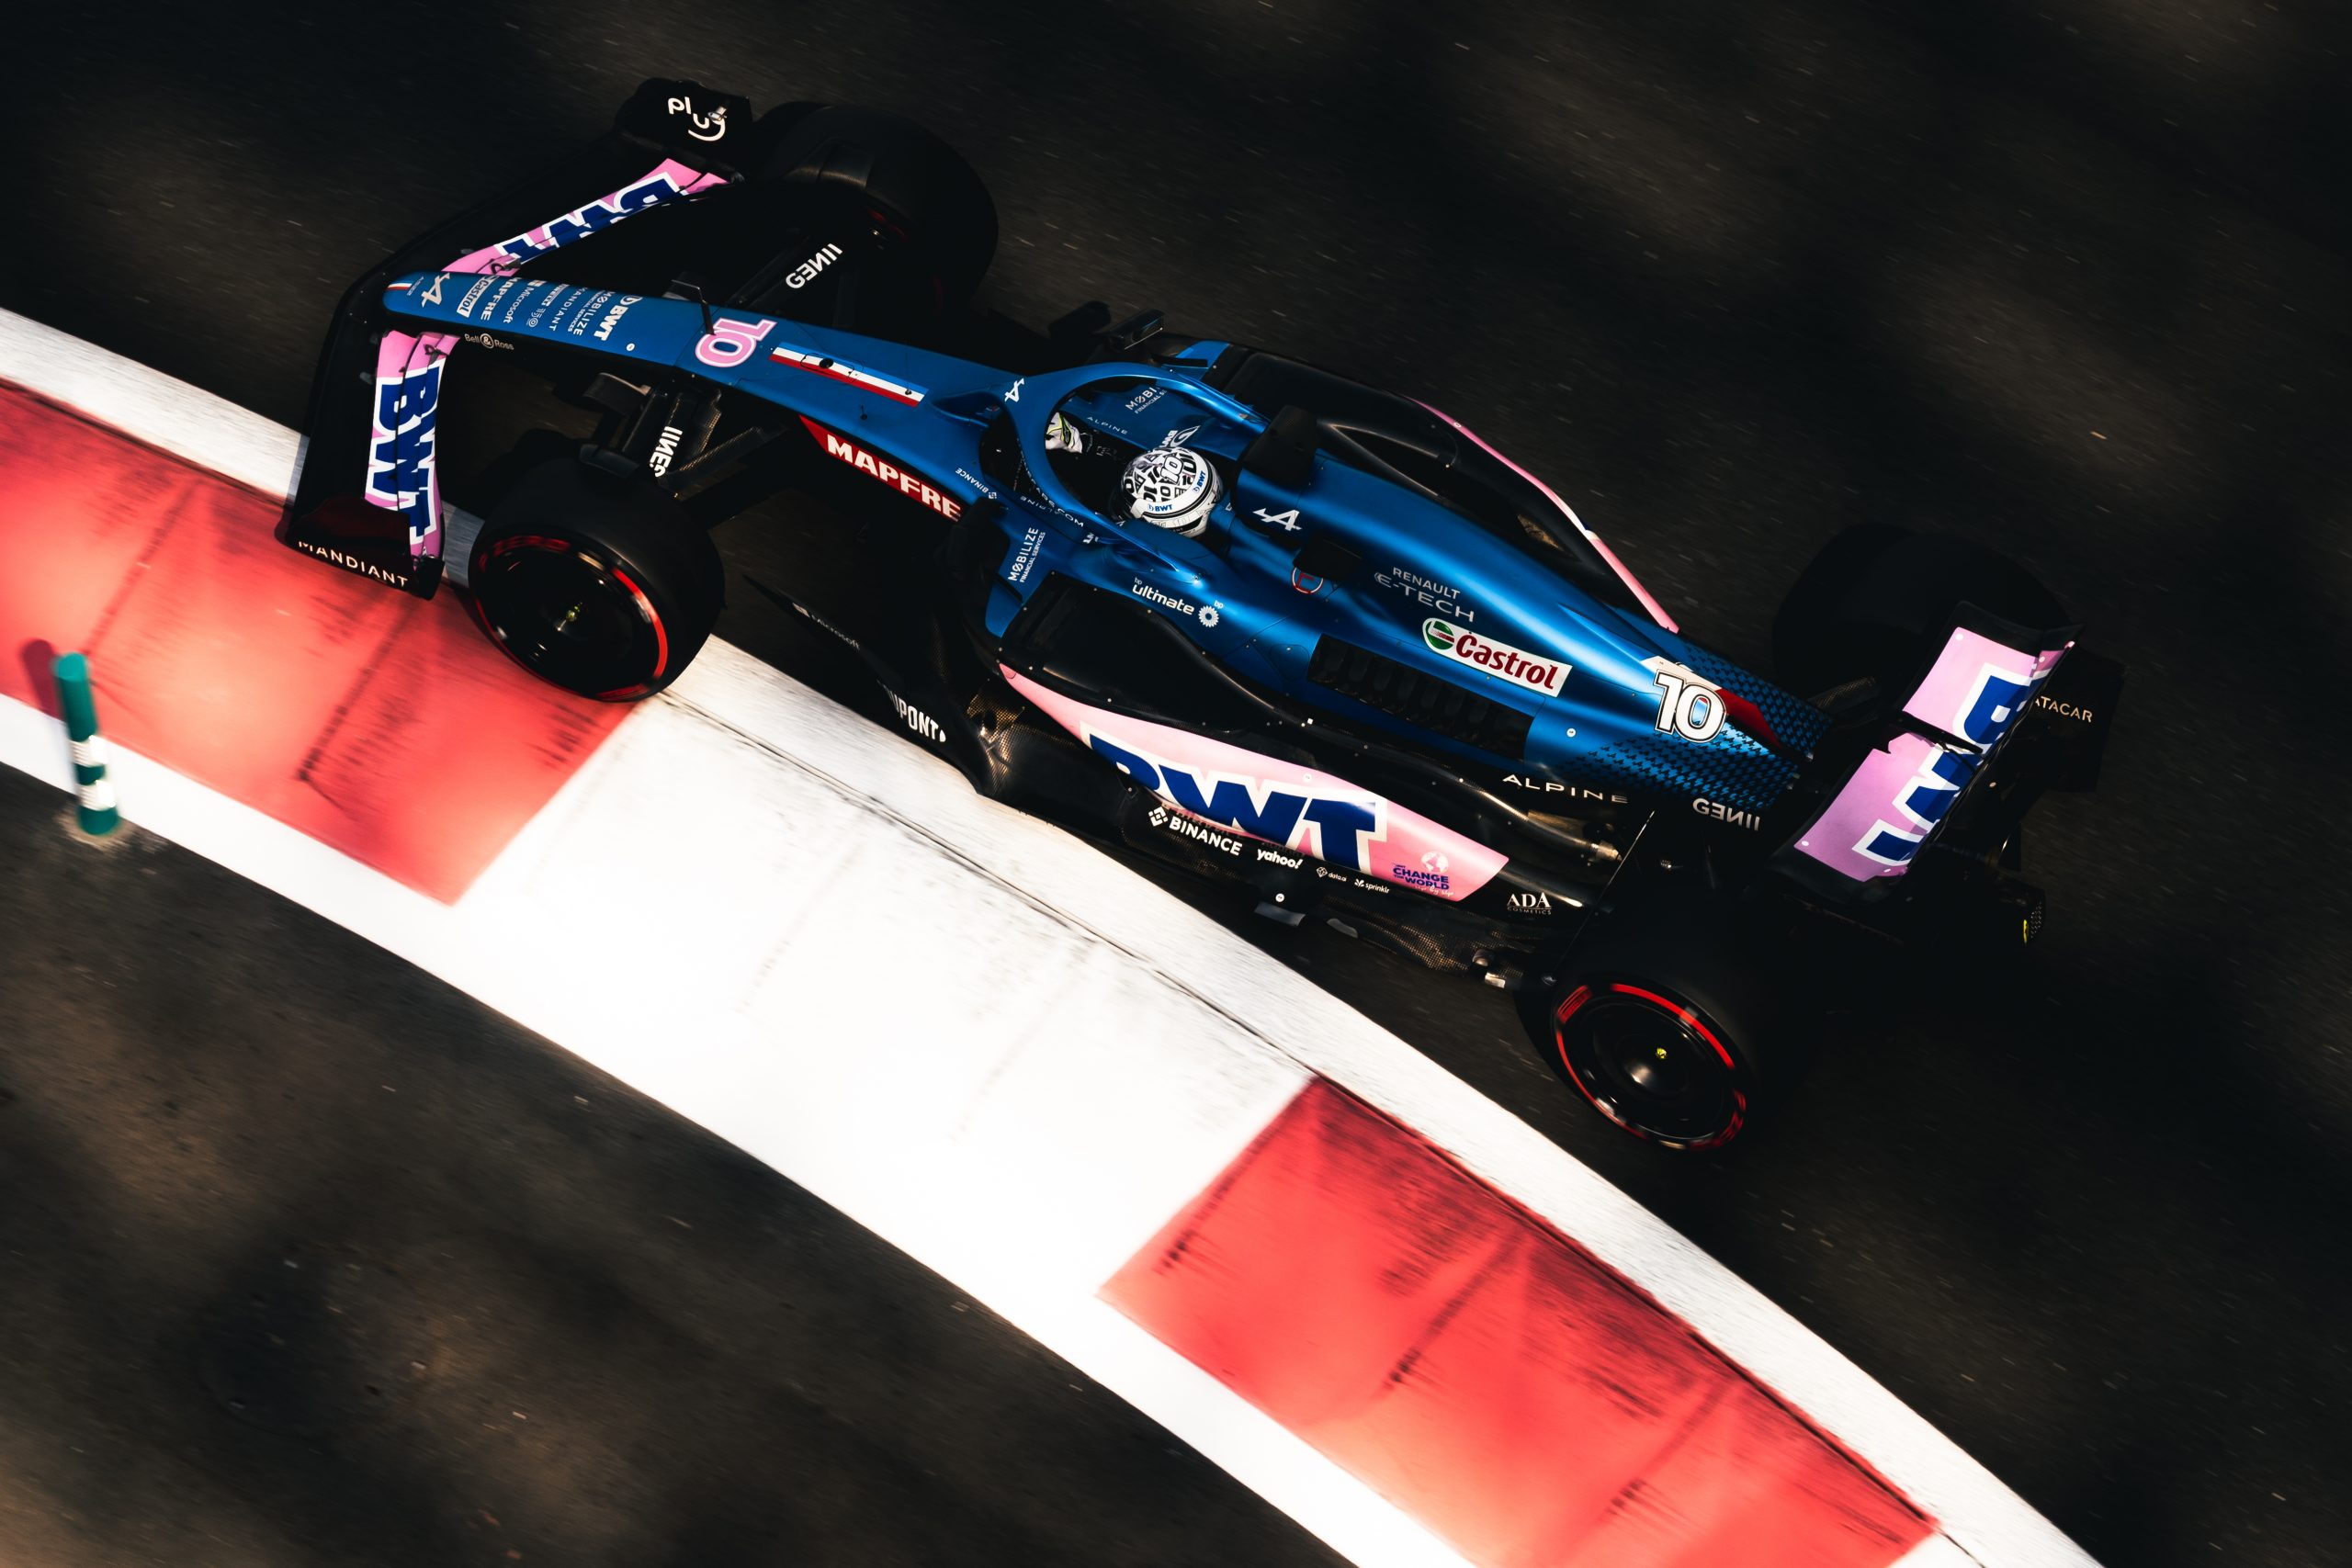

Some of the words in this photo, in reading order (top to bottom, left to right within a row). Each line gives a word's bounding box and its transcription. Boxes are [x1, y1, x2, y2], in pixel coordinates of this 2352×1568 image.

[667, 96, 726, 142] plug
[503, 287, 535, 323] Microsoft
[594, 304, 629, 342] BWT
[464, 333, 480, 344] Bell
[494, 340, 514, 350] Ross
[695, 317, 777, 367] 10
[1087, 416, 1128, 435] ALPINE
[826, 434, 962, 522] MAPFRE
[956, 467, 989, 498] BINANCE
[1160, 456, 1183, 485] 10
[1197, 470, 1206, 487] BWT
[1033, 531, 1046, 556] SERVICES
[299, 541, 408, 587] MANDIANT
[1376, 572, 1475, 623] E-TECH
[1392, 566, 1461, 600] RENAULT
[1132, 584, 1194, 615] ultimate
[1456, 630, 1561, 693] Castrol
[1654, 671, 1727, 744] 10
[1501, 773, 1629, 805] ALPINE
[1169, 816, 1243, 856] BINANCE
[1257, 846, 1303, 870] yahoo!
[1328, 871, 1347, 882] data.ai
[1365, 880, 1390, 895] sprinklr
[1393, 867, 1449, 884] CHANGE
[1405, 876, 1450, 890] WORLD
[1507, 892, 1552, 908] ADA
[1507, 907, 1552, 915] COSMETICS
